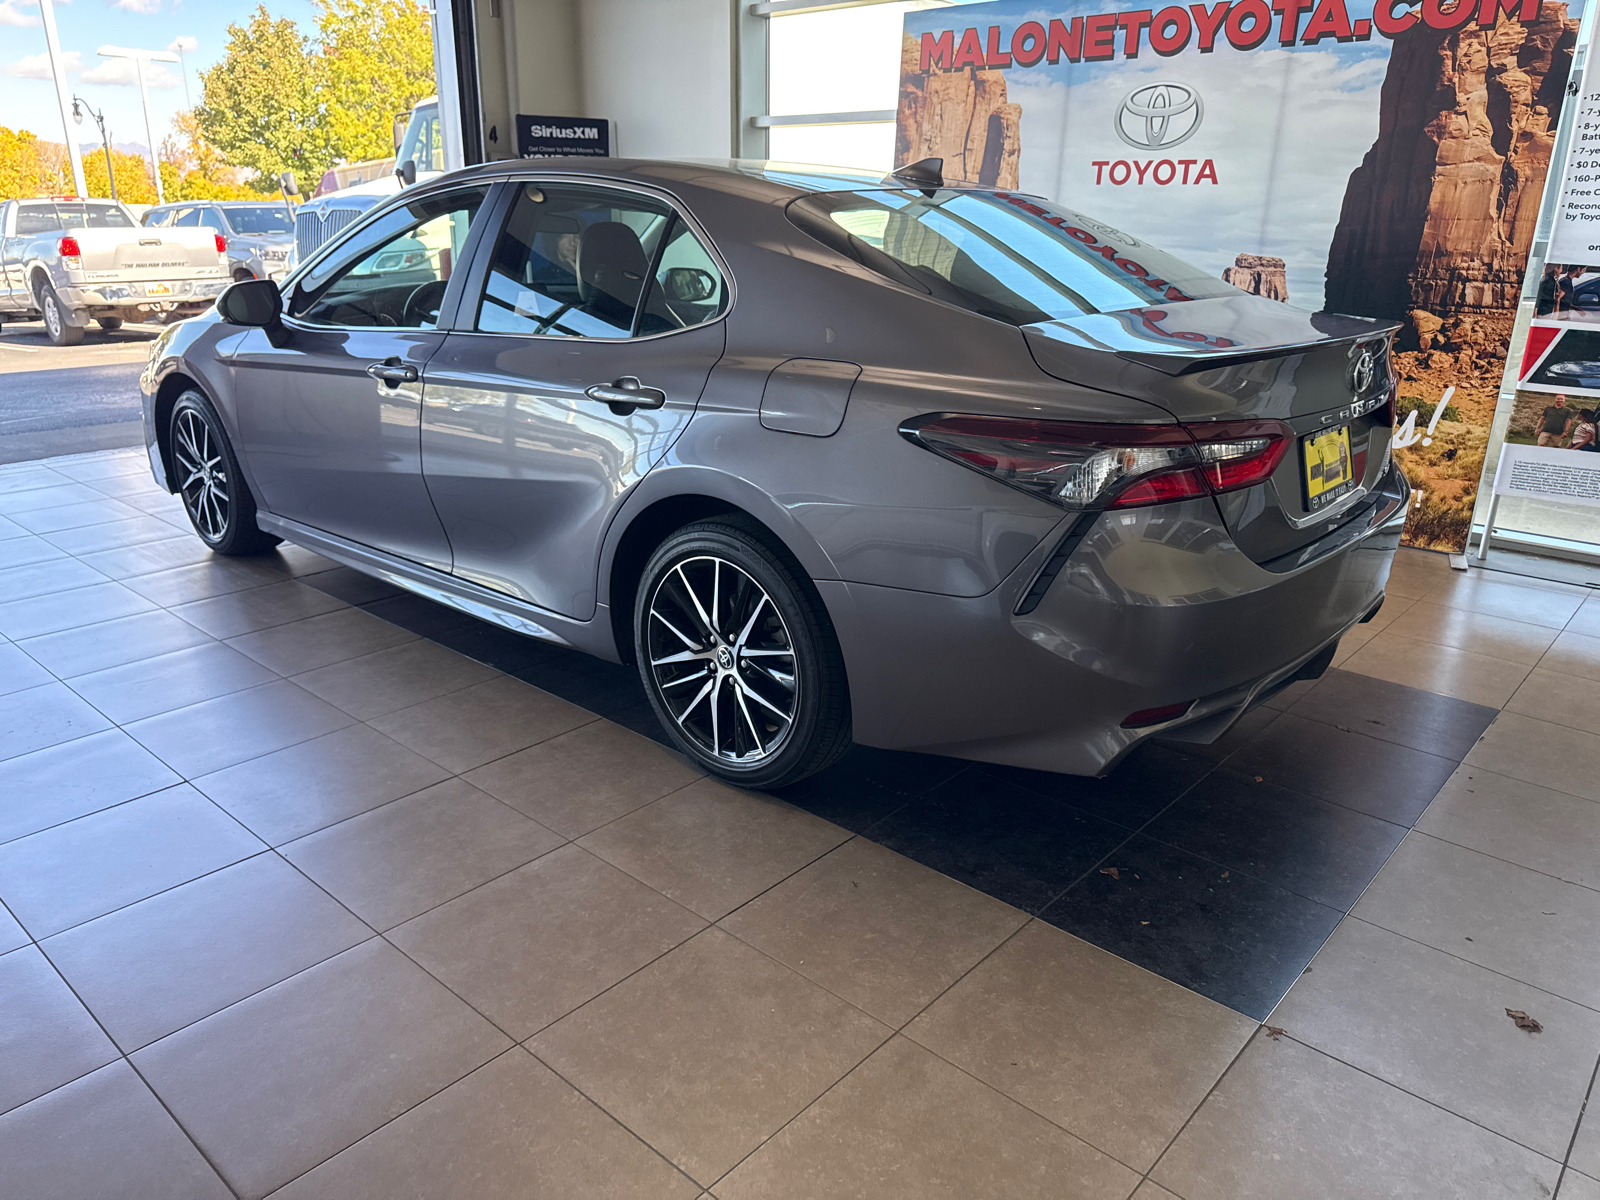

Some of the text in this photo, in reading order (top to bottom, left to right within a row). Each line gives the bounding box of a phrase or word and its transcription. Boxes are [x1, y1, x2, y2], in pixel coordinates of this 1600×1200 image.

[919, 0, 1541, 73] MALONETOYOTA.COM
[489, 125, 498, 144] 4
[530, 124, 599, 140] SiriusXM
[1091, 158, 1219, 186] TOYOTA
[1576, 160, 1589, 169] $0
[1570, 188, 1592, 196] Free
[1565, 212, 1578, 221] by
